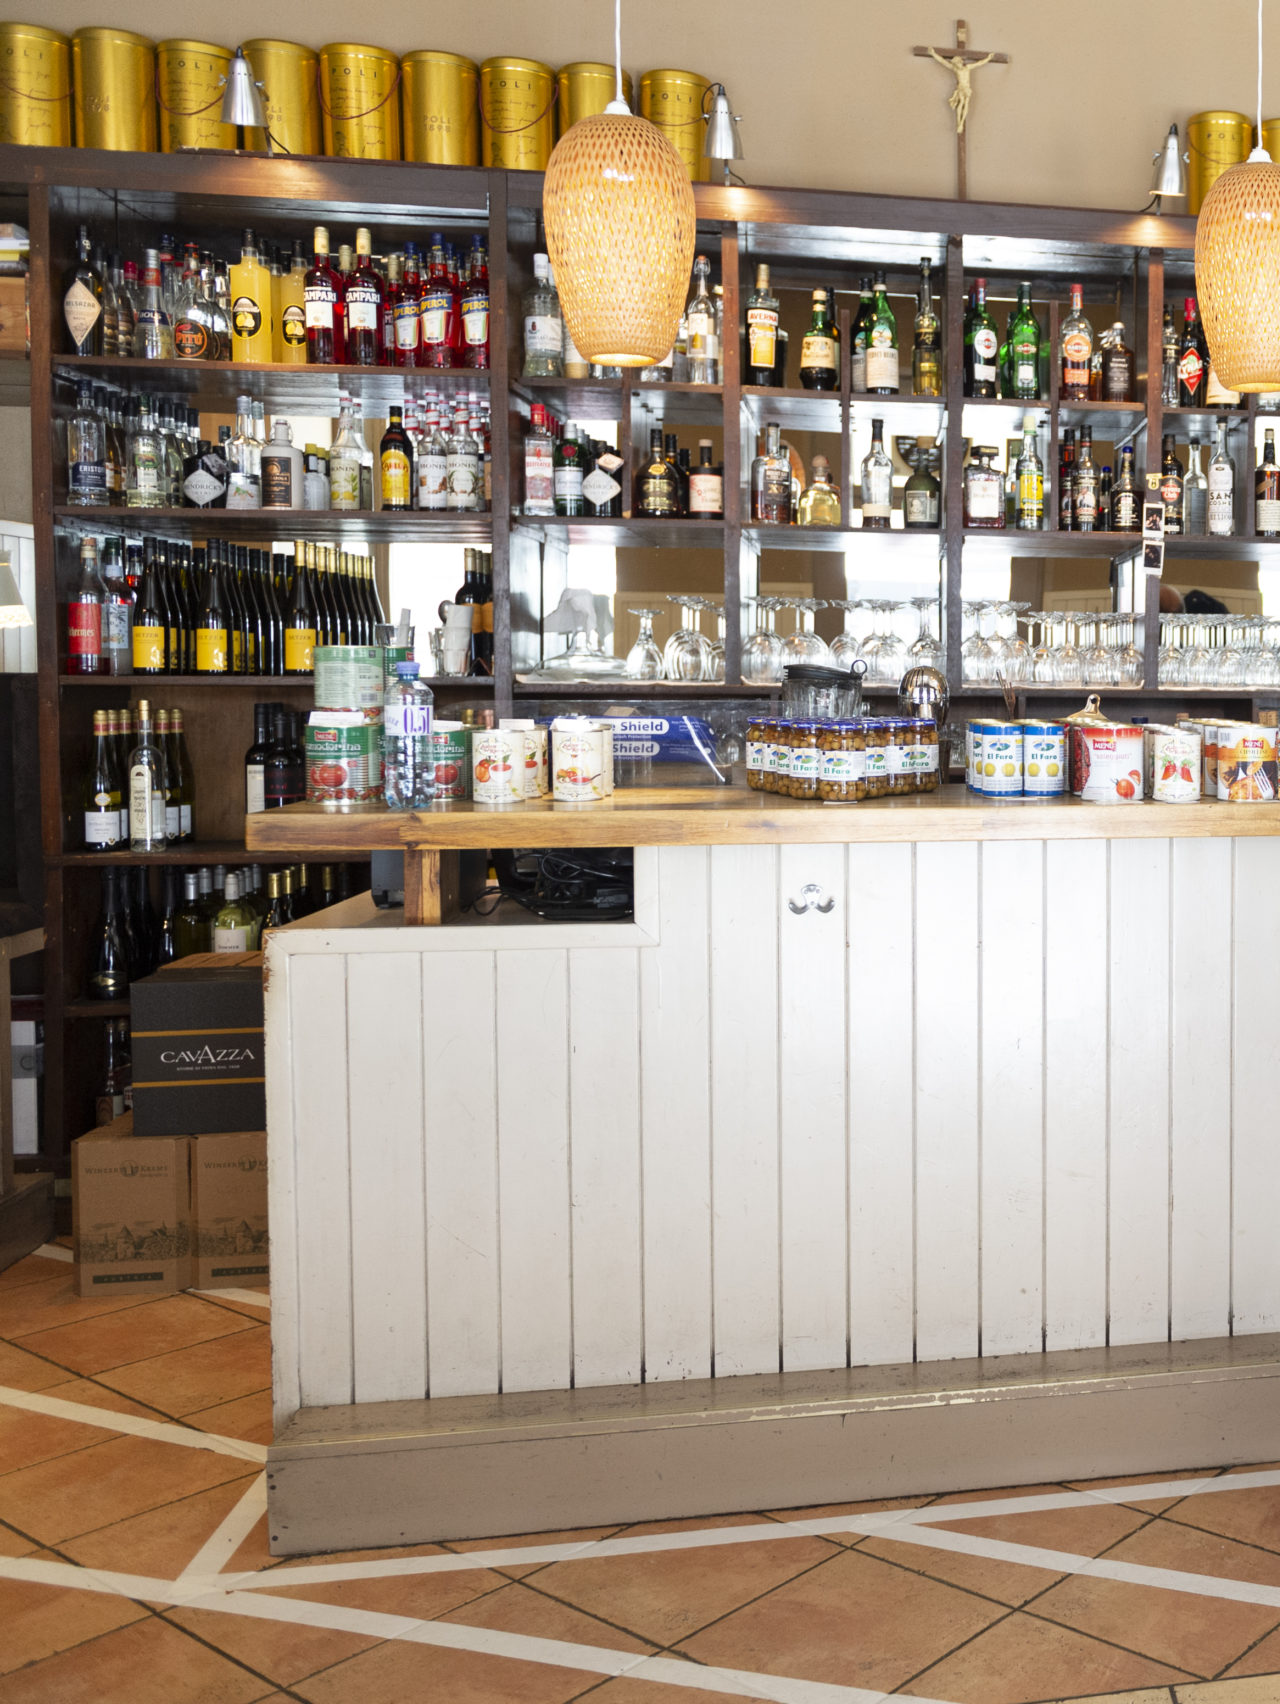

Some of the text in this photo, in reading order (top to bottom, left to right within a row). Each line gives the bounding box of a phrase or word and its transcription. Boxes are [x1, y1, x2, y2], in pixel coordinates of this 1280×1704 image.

[6, 48, 43, 60] OLI
[332, 67, 377, 79] POLI
[489, 80, 532, 90] POLI
[420, 299, 448, 311] APEROL
[750, 312, 777, 322] AVERNA
[621, 721, 663, 731] Shield
[613, 743, 654, 753] Shield
[160, 1045, 255, 1064] CAVAZZA
